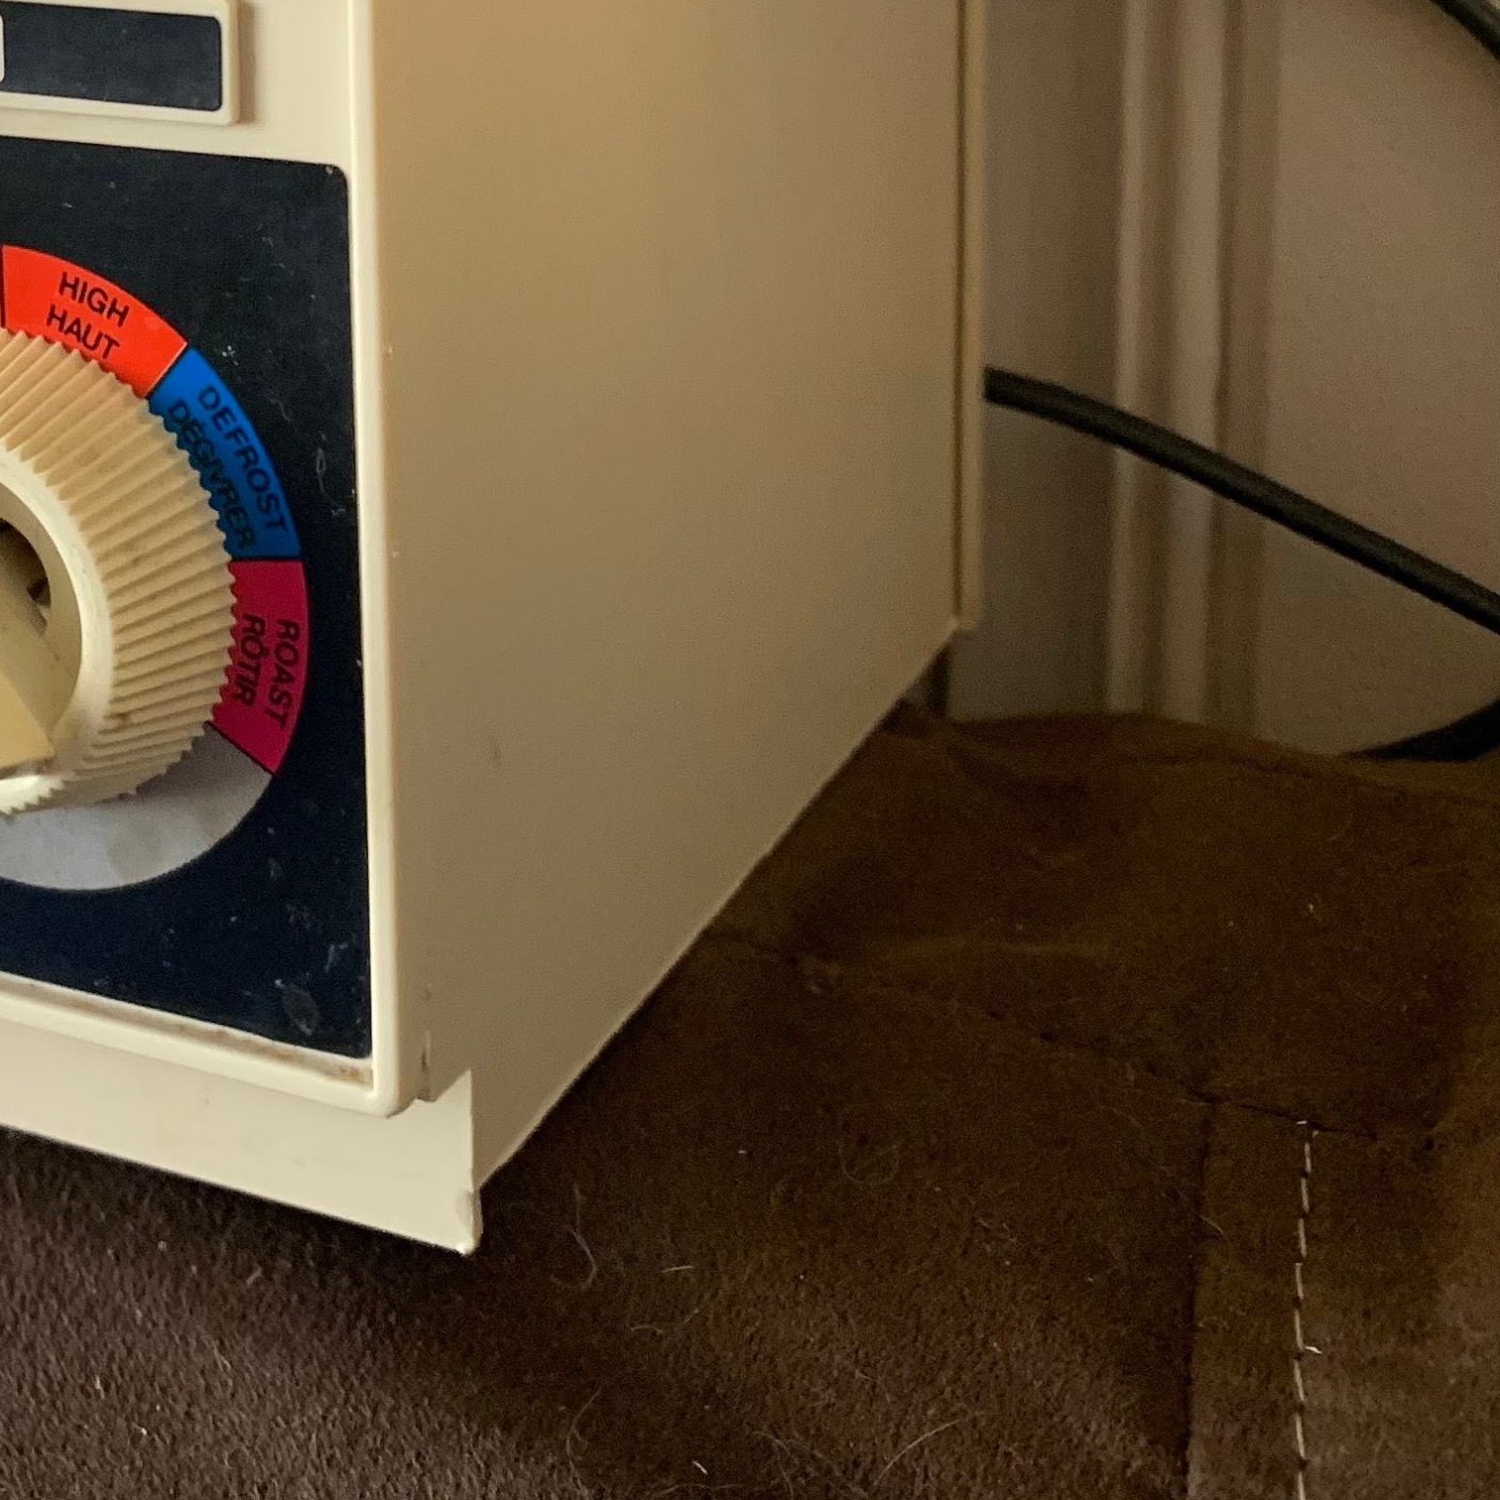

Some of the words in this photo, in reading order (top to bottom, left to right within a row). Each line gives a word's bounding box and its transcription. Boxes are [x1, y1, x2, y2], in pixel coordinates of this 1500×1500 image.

[45, 303, 121, 360] HAUT
[58, 271, 130, 328] HIGH
[197, 385, 290, 534] DEFROST
[264, 617, 301, 731] ROAST
